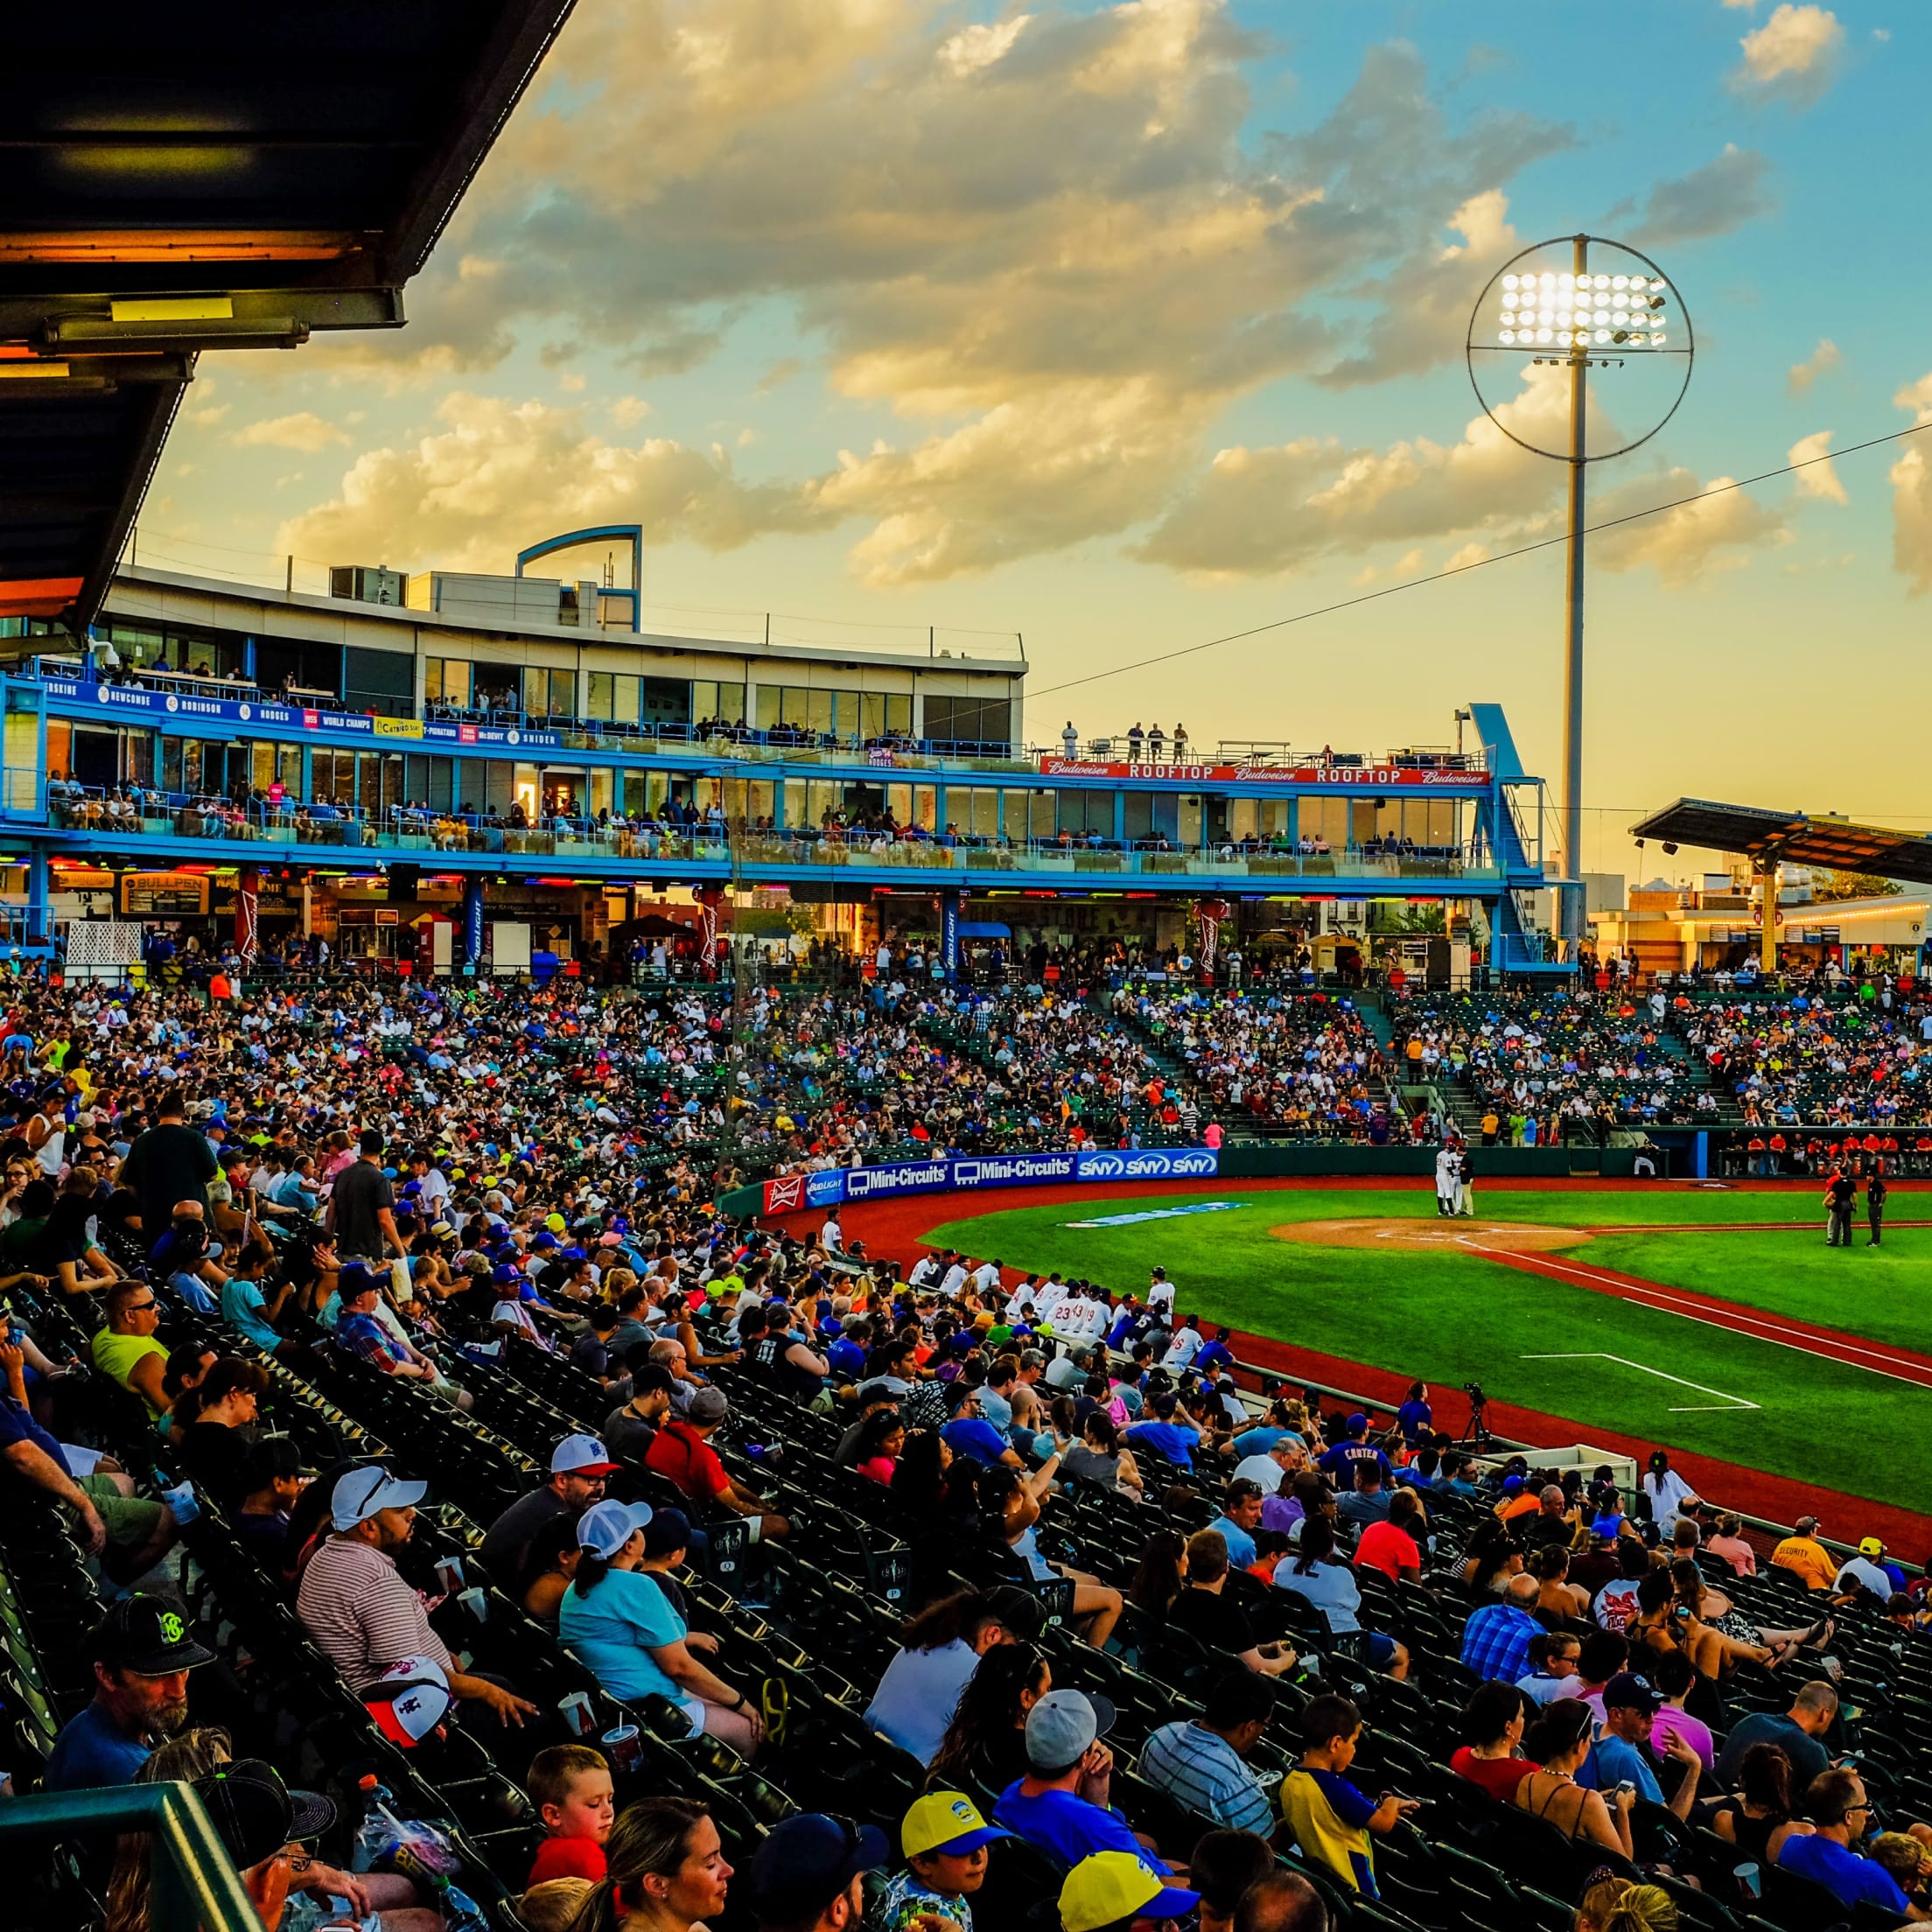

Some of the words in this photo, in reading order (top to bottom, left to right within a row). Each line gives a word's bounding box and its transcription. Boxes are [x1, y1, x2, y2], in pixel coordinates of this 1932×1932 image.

[110, 691, 150, 706] NEWCOMBE
[181, 700, 221, 714] ROBINSON
[260, 710, 290, 721] HODGES
[322, 716, 345, 727] WORLD
[346, 718, 371, 729] CHAMPS
[382, 723, 410, 733] CATBIRD
[522, 733, 556, 745] SNIDER
[1046, 760, 1110, 776] Budweiser
[1129, 763, 1214, 780] ROOFTOP
[1234, 767, 1294, 781] Budweiser
[1316, 769, 1401, 784] ROOFTOP
[1421, 770, 1484, 784] Budweiser
[137, 878, 203, 890] BULLPEN
[933, 898, 940, 909] 5
[959, 898, 966, 909] 5
[473, 900, 482, 935] LIGHT
[946, 943, 955, 970] BUD
[981, 1159, 1071, 1180] Mini-Circuits
[1078, 1160, 1116, 1176] SNY
[1125, 1159, 1164, 1175] SNY
[1172, 1158, 1210, 1173] SNY
[870, 1166, 946, 1189] Mini-Circuits
[808, 1181, 824, 1192] BUD
[823, 1179, 844, 1190] LIGHT
[1055, 1307, 1070, 1320] 23
[1072, 1304, 1084, 1318] 43
[1344, 1447, 1378, 1460] CARTER
[1779, 1546, 1809, 1558] SECURITY
